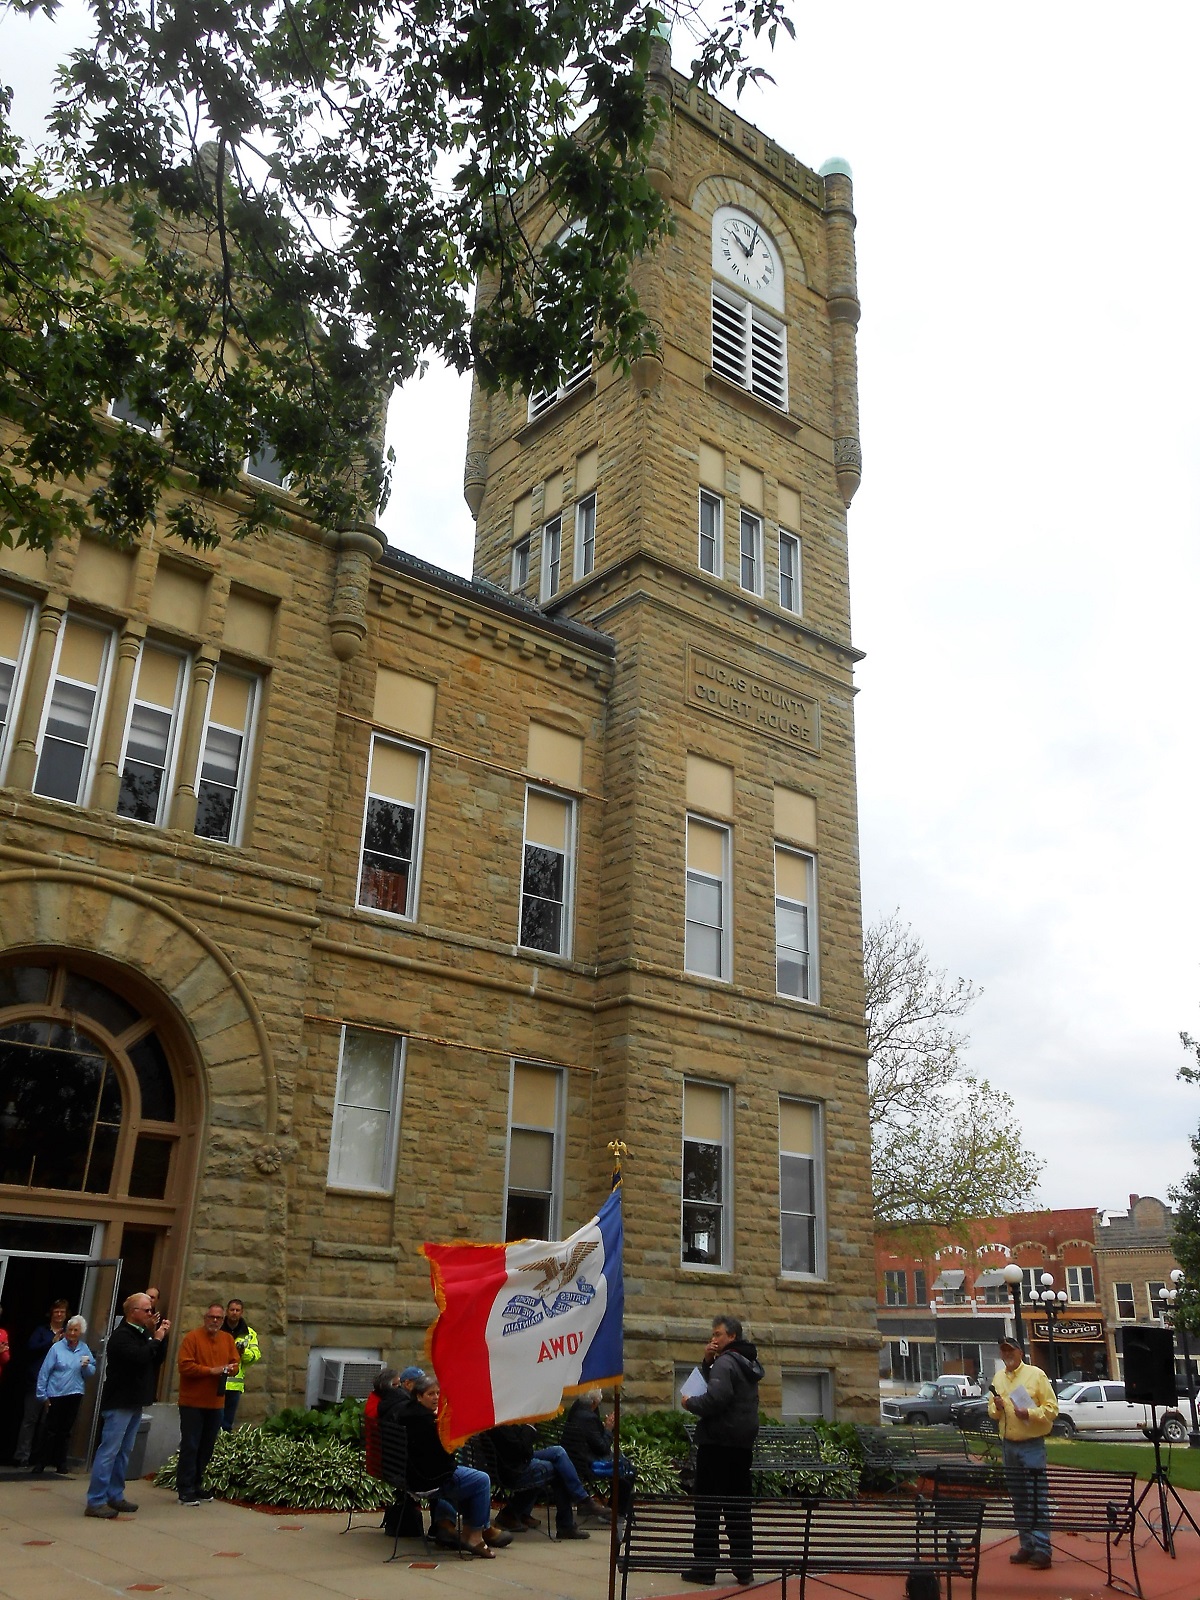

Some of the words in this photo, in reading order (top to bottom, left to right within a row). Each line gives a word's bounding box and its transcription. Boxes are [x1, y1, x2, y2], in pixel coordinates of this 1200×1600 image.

[694, 658, 747, 693] LUCAS
[751, 684, 809, 720] COUNTY
[694, 684, 752, 718] COURT
[756, 707, 811, 742] HOUSE
[1060, 1325, 1097, 1334] OFFICE
